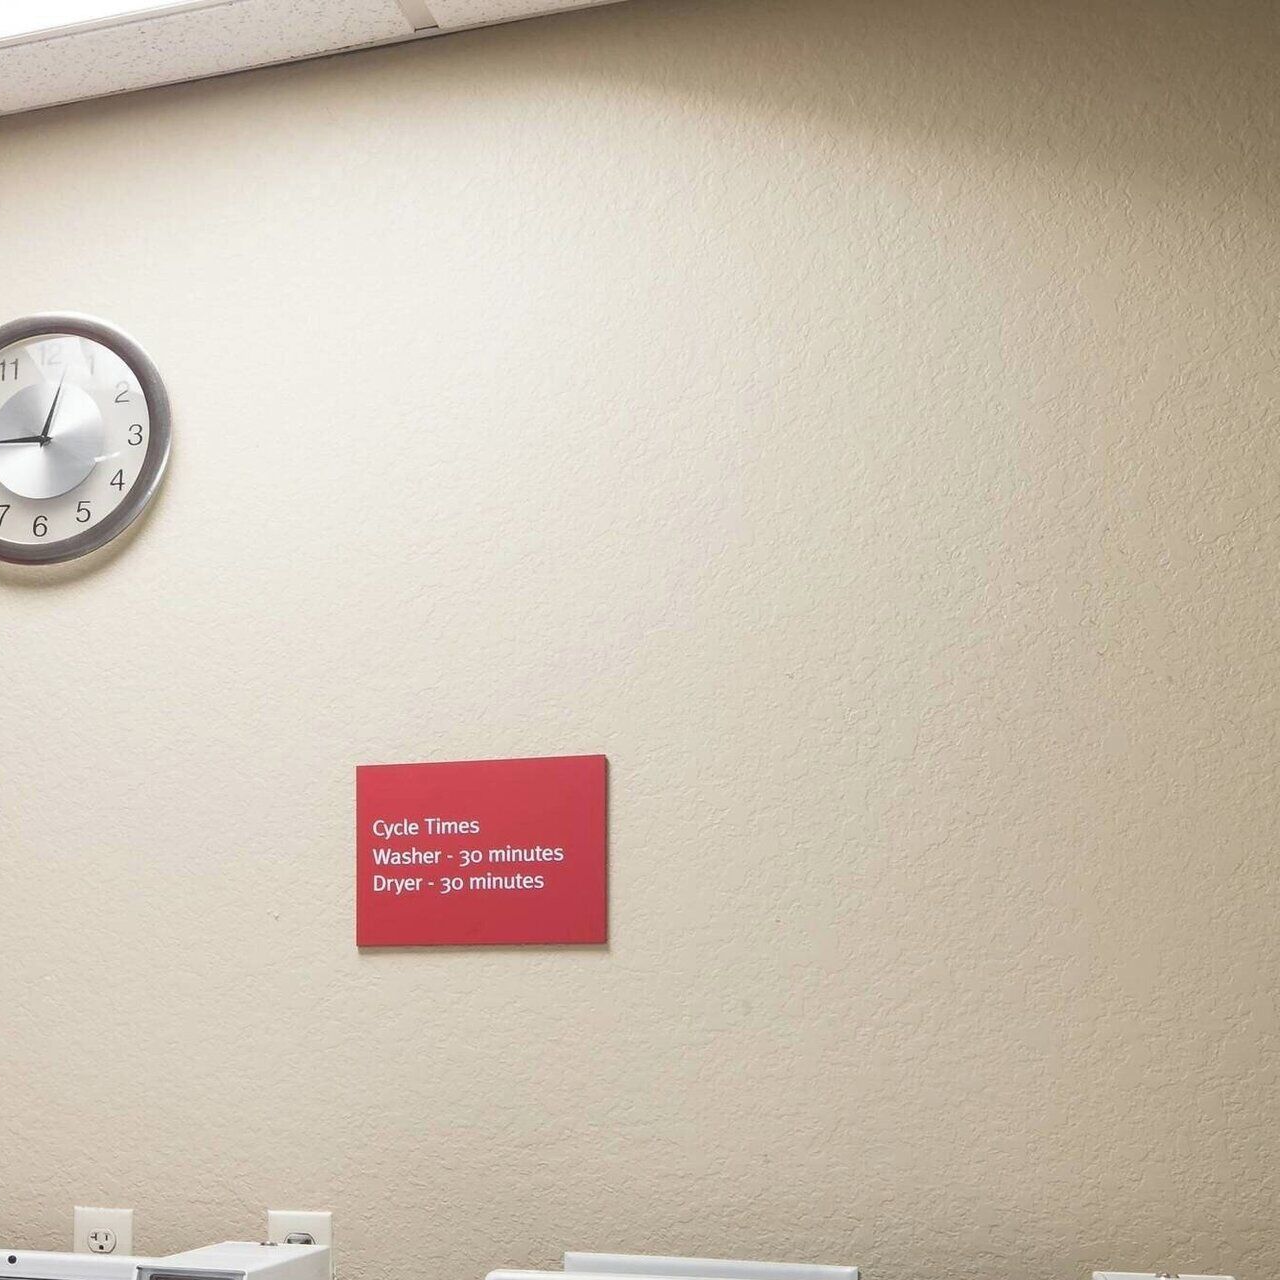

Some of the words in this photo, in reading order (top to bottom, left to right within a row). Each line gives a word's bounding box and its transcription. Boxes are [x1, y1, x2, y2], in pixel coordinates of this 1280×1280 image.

[114, 381, 130, 404] 2
[127, 423, 144, 447] 3
[109, 468, 126, 491] 4
[75, 500, 92, 524] 5
[32, 515, 49, 538] 6
[372, 818, 420, 840] Cycle
[424, 817, 481, 835] Times
[372, 846, 442, 866] Washer
[459, 849, 483, 867] 30
[488, 844, 565, 863] minutes
[372, 874, 424, 896] Dryer
[440, 876, 464, 894] 30
[469, 871, 545, 891] minutes
